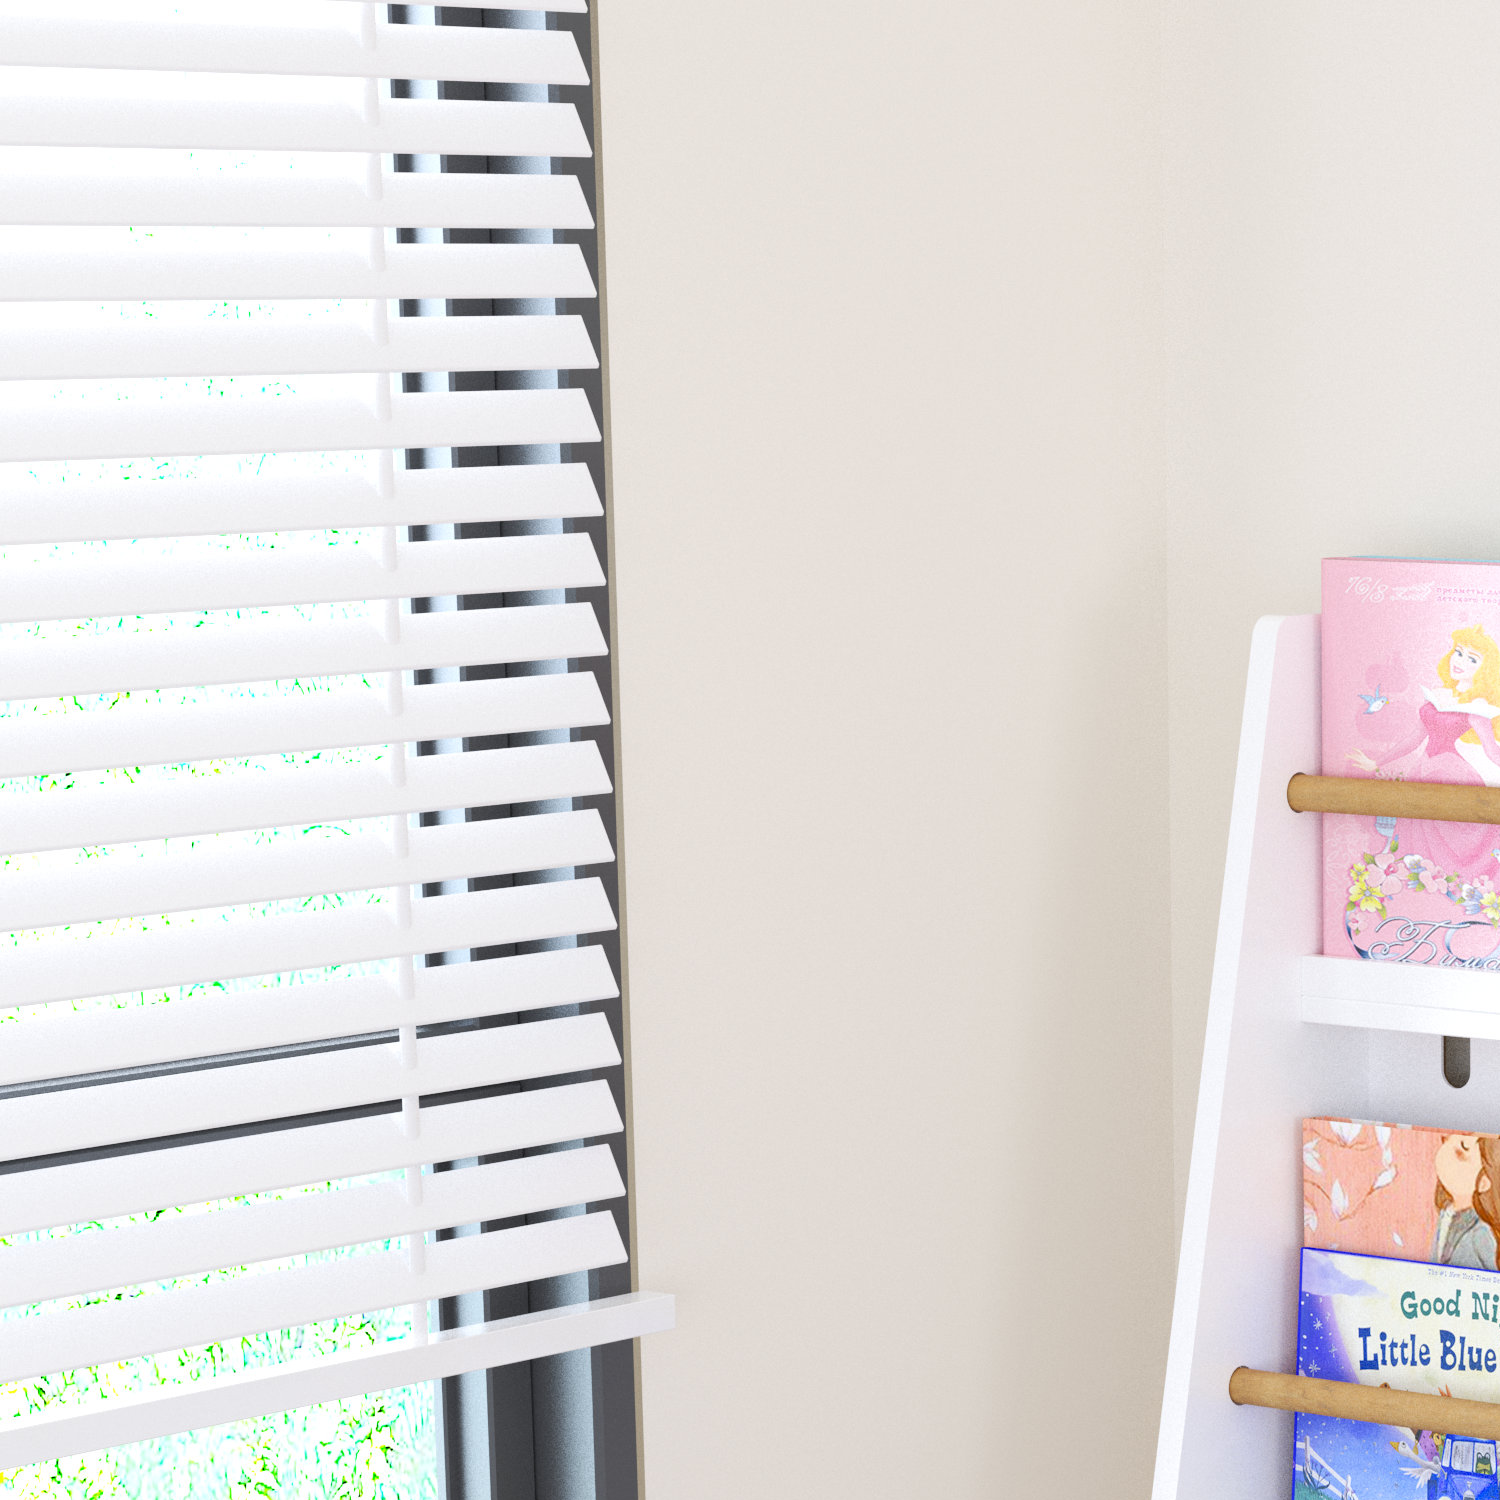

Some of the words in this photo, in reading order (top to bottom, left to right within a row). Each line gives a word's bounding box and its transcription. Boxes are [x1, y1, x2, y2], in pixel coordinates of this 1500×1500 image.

[1400, 1289, 1462, 1320] Good
[1358, 1327, 1431, 1371] Little
[1439, 1329, 1497, 1373] Blue
